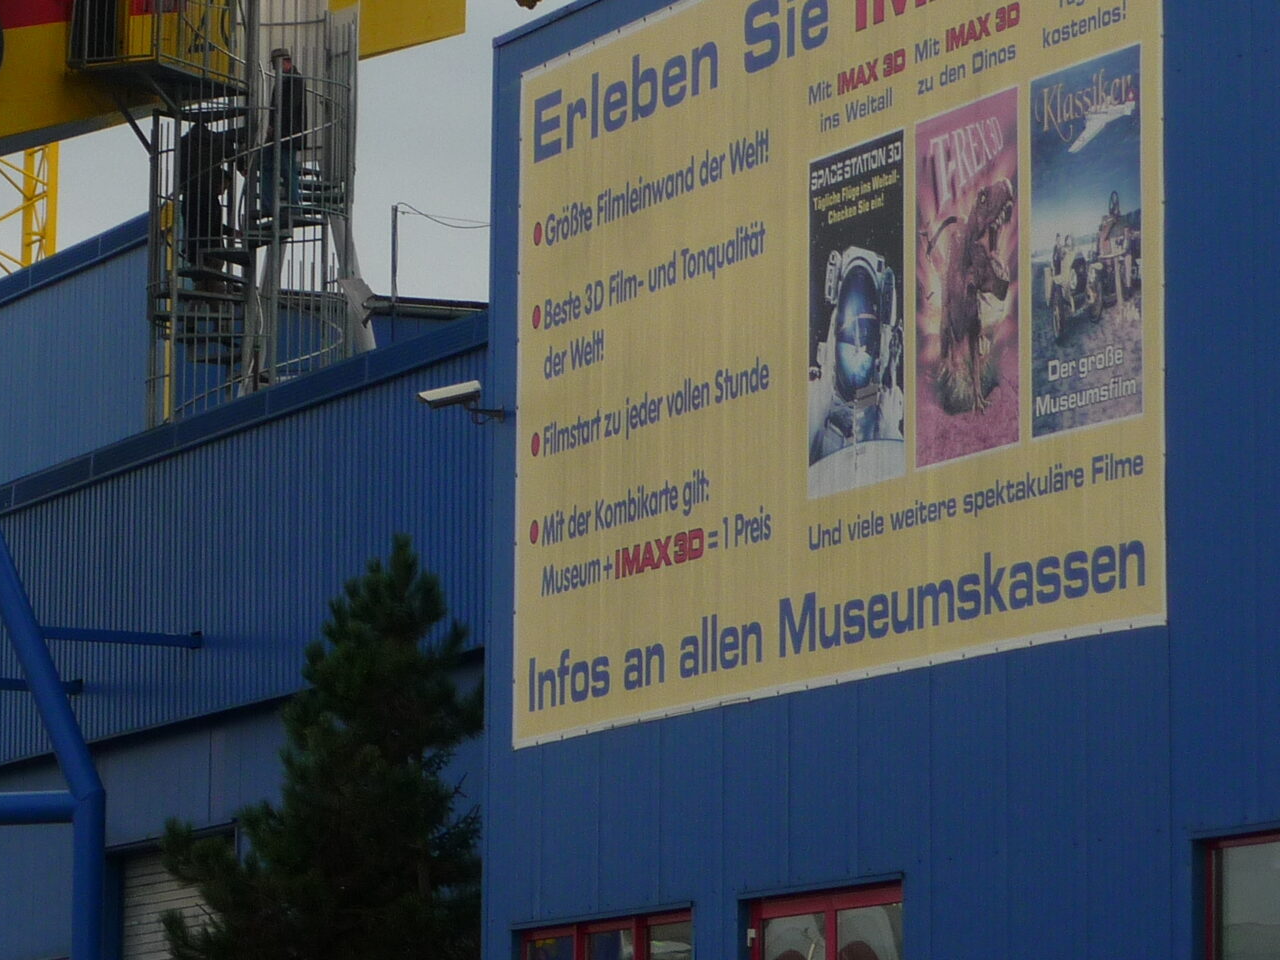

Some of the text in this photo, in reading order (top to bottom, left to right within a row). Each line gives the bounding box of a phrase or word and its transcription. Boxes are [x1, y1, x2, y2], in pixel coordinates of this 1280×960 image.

[914, 38, 940, 64] Mit
[917, 43, 1017, 95] zu den Dinos
[533, 41, 718, 162] Erleben
[808, 81, 832, 106] Mit
[820, 87, 893, 133] ins Weltall
[545, 128, 769, 246] Größte Filmleinwand der Welt!
[858, 198, 869, 214] Sie
[544, 221, 765, 330] Beste 3D Film- und Tonqualität
[544, 329, 604, 379] der Welt!
[1048, 346, 1123, 381] Der große
[543, 356, 769, 456] Filmstart zu jeder vollen Stunde
[1036, 377, 1136, 417] Museumsfilm
[541, 468, 710, 546] Mit der Kombikarte gilt:
[735, 505, 771, 547] Preis
[809, 453, 1144, 551] Und viele weitere spektakuläre Filme
[528, 539, 1147, 712] Infos an allen Museumskassen
